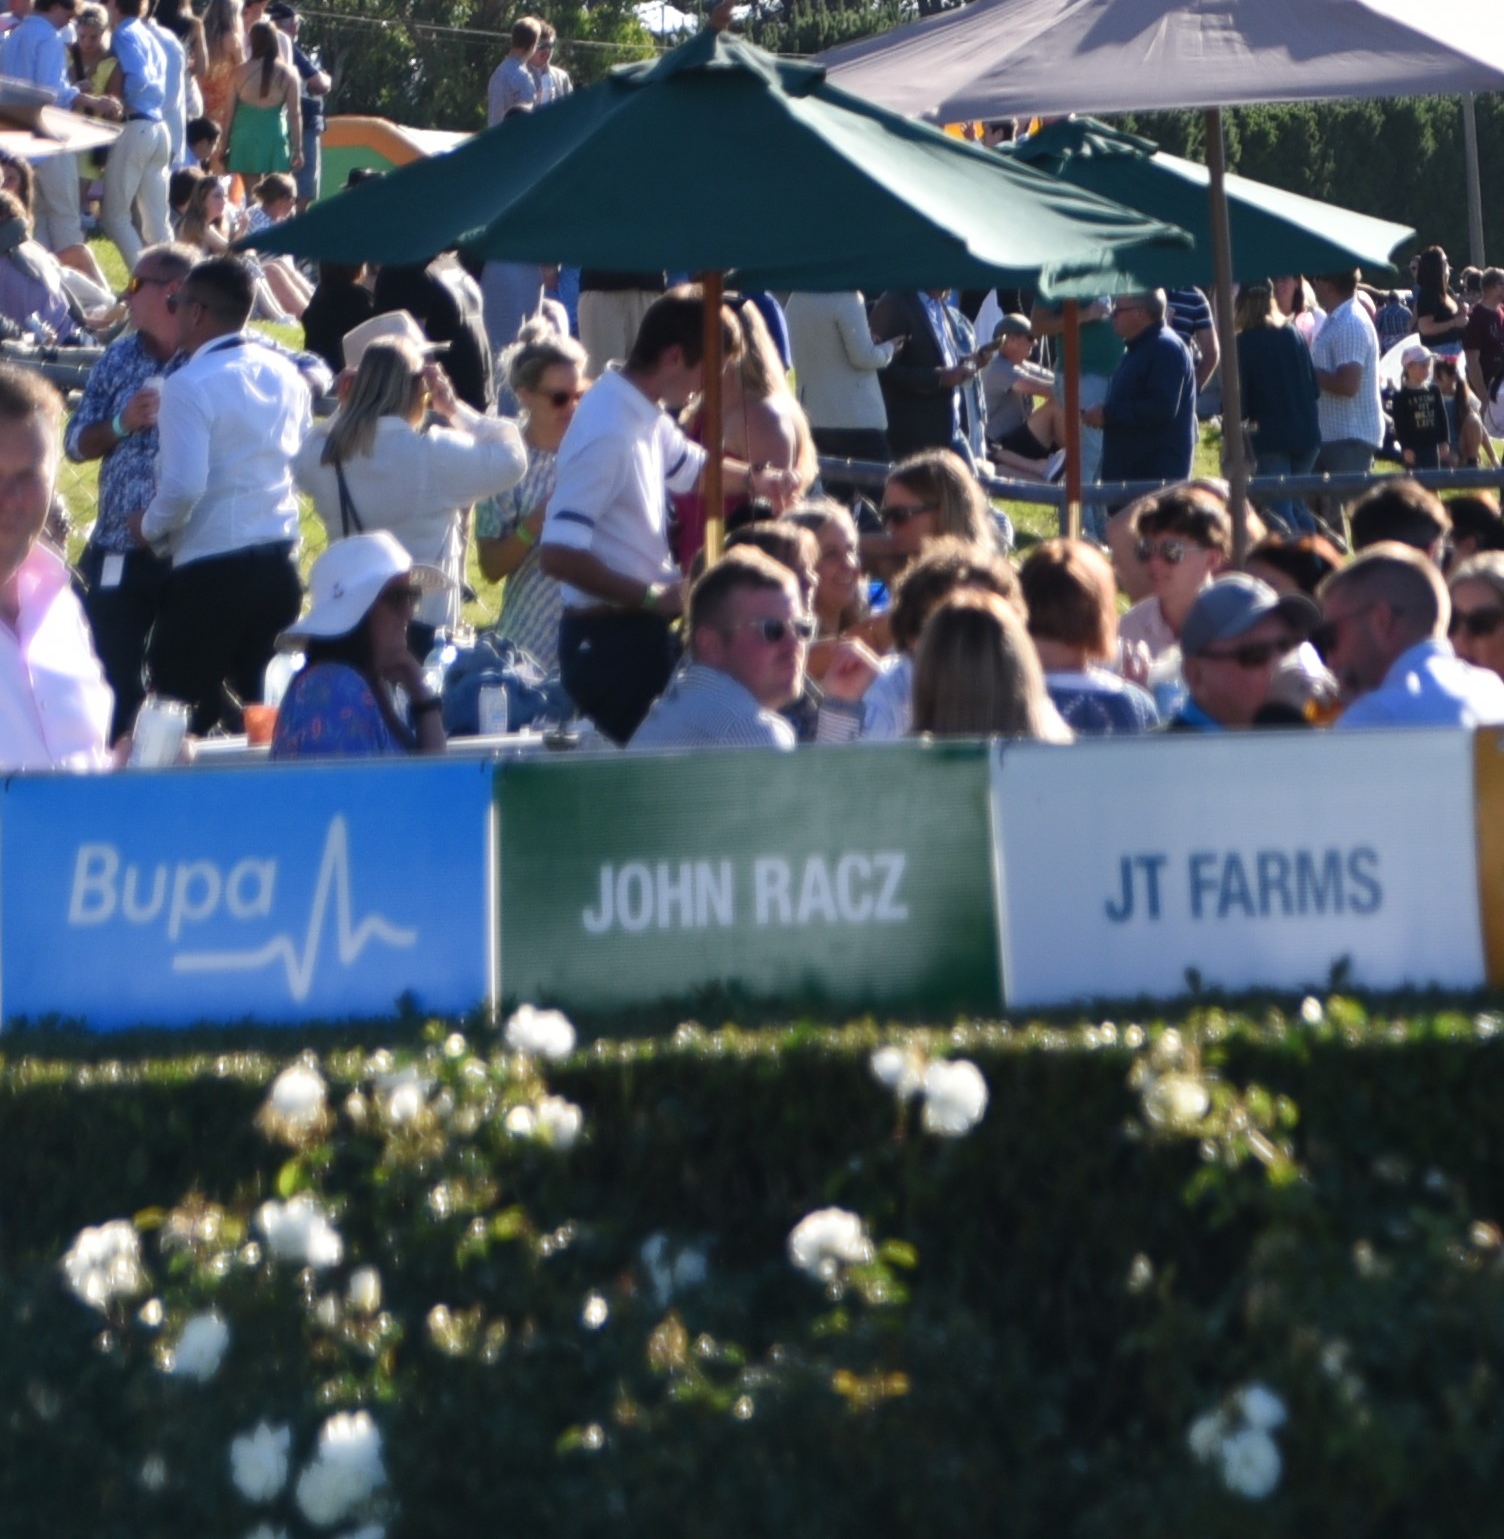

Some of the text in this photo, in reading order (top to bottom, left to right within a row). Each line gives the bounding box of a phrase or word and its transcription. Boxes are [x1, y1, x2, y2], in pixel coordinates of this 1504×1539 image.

[68, 843, 277, 942] Bupa
[582, 853, 908, 932] JOHN RACZ
[1105, 847, 1383, 922] JT FARMS
